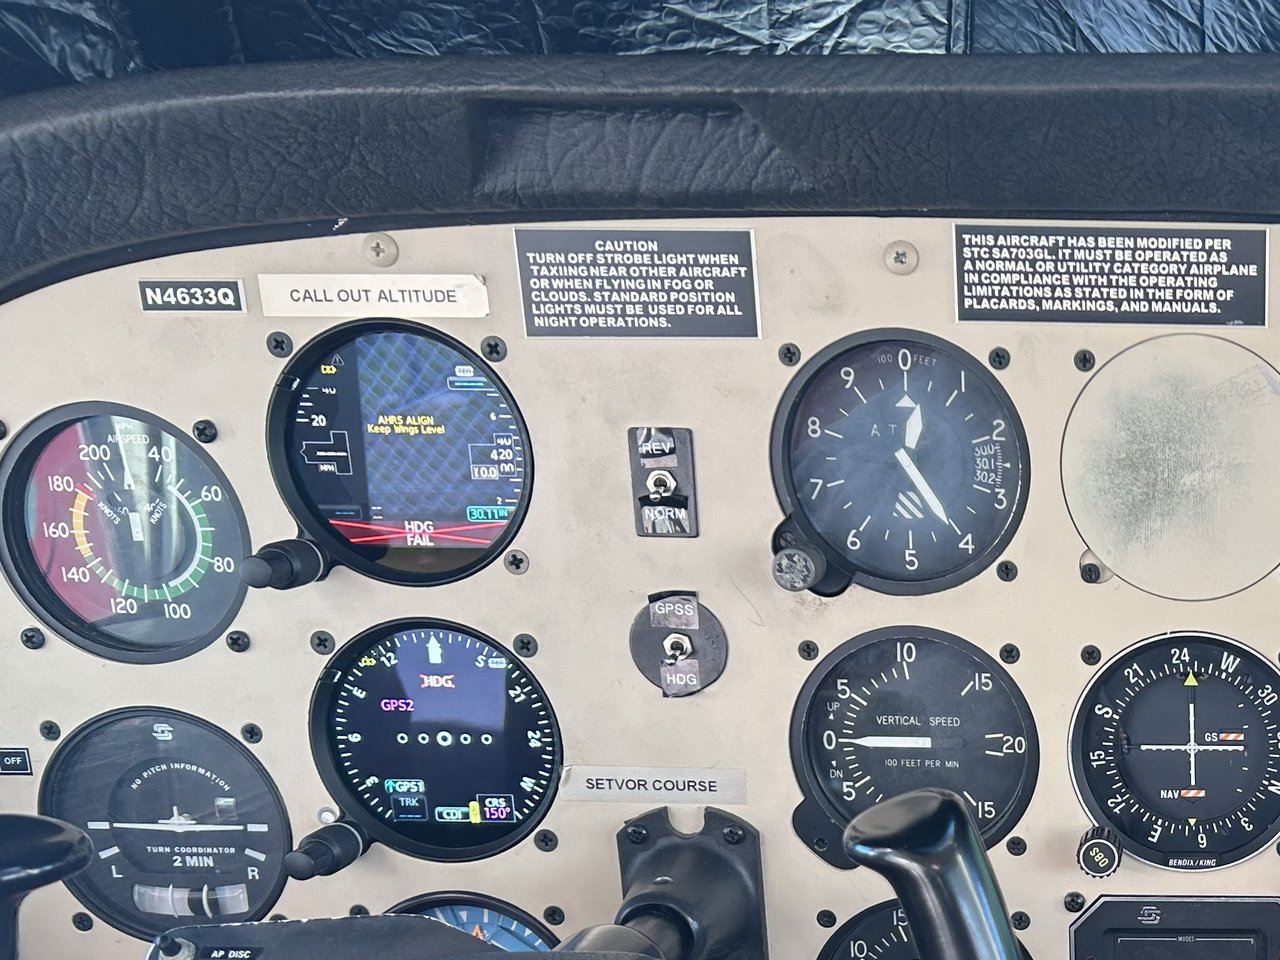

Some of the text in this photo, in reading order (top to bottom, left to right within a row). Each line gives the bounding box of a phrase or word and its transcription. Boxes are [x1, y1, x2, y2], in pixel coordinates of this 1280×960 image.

[595, 241, 658, 251] CAUTION
[963, 234, 1232, 250] THIS AIRCRAFT HAS BEEN MODIFIED PER
[527, 253, 738, 264] TURN OFF STROBE LIGHT WHEN
[963, 248, 1228, 263] STC SA703GL. IT MUST BE OPERATED AS
[531, 266, 747, 277] TAXIING NEAR OTHER AIRCRAFT
[530, 279, 714, 290] OR WHEN FLYING IN FOG OR
[144, 287, 235, 306] N4633Q
[290, 288, 457, 304] CALL OUT ALTITUDE
[531, 292, 735, 302] CLOUDS. STANDARD POSITION
[532, 304, 742, 315] LIGHTS MUST BE USED FOR ALL
[534, 317, 671, 327] NIGHT OPERATIONS.
[378, 416, 433, 425] AHRS ALIGN
[368, 425, 445, 435] Keep Wings Level
[79, 445, 110, 460] 200
[642, 443, 671, 454] REV
[645, 508, 686, 520] NORM
[405, 521, 433, 532] HDG
[407, 535, 434, 546] FAIL
[656, 602, 695, 615] GPSS
[667, 674, 696, 685] HDG
[380, 700, 414, 712] GPS2
[876, 716, 960, 726] VERTICAL SPEED
[586, 778, 718, 792] SETVOR COURSE
[173, 856, 214, 867] 2 MIN
[211, 950, 251, 958] AP DISC
